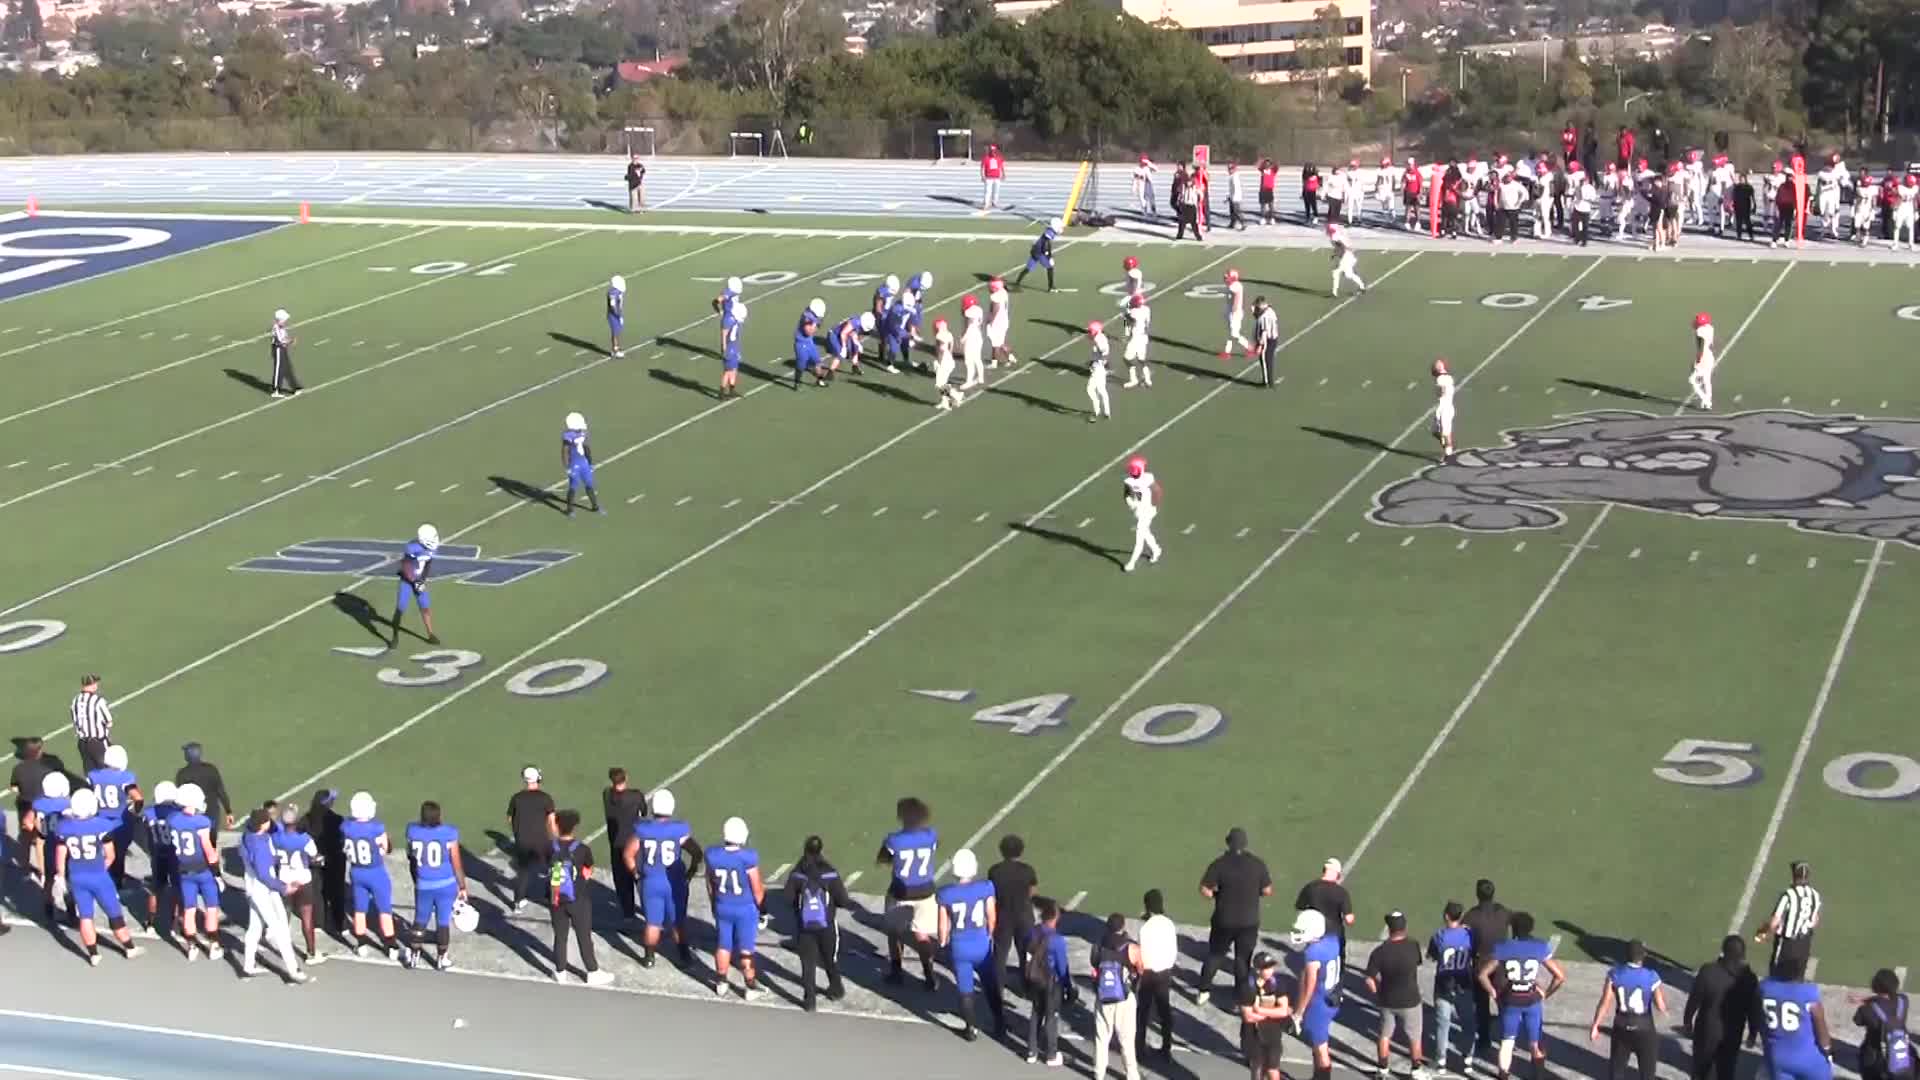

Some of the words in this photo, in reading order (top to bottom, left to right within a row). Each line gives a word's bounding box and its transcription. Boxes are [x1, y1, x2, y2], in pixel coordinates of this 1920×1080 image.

[377, 650, 608, 696] 30
[970, 694, 1223, 744] 40
[1653, 739, 1920, 798] 50
[66, 836, 97, 860] 65
[412, 841, 441, 867] 70
[644, 839, 675, 866] 76
[899, 848, 932, 877] 77
[715, 868, 742, 895] 71
[952, 900, 984, 929] 74
[1618, 986, 1644, 1014] 14
[1763, 999, 1800, 1032] 56
